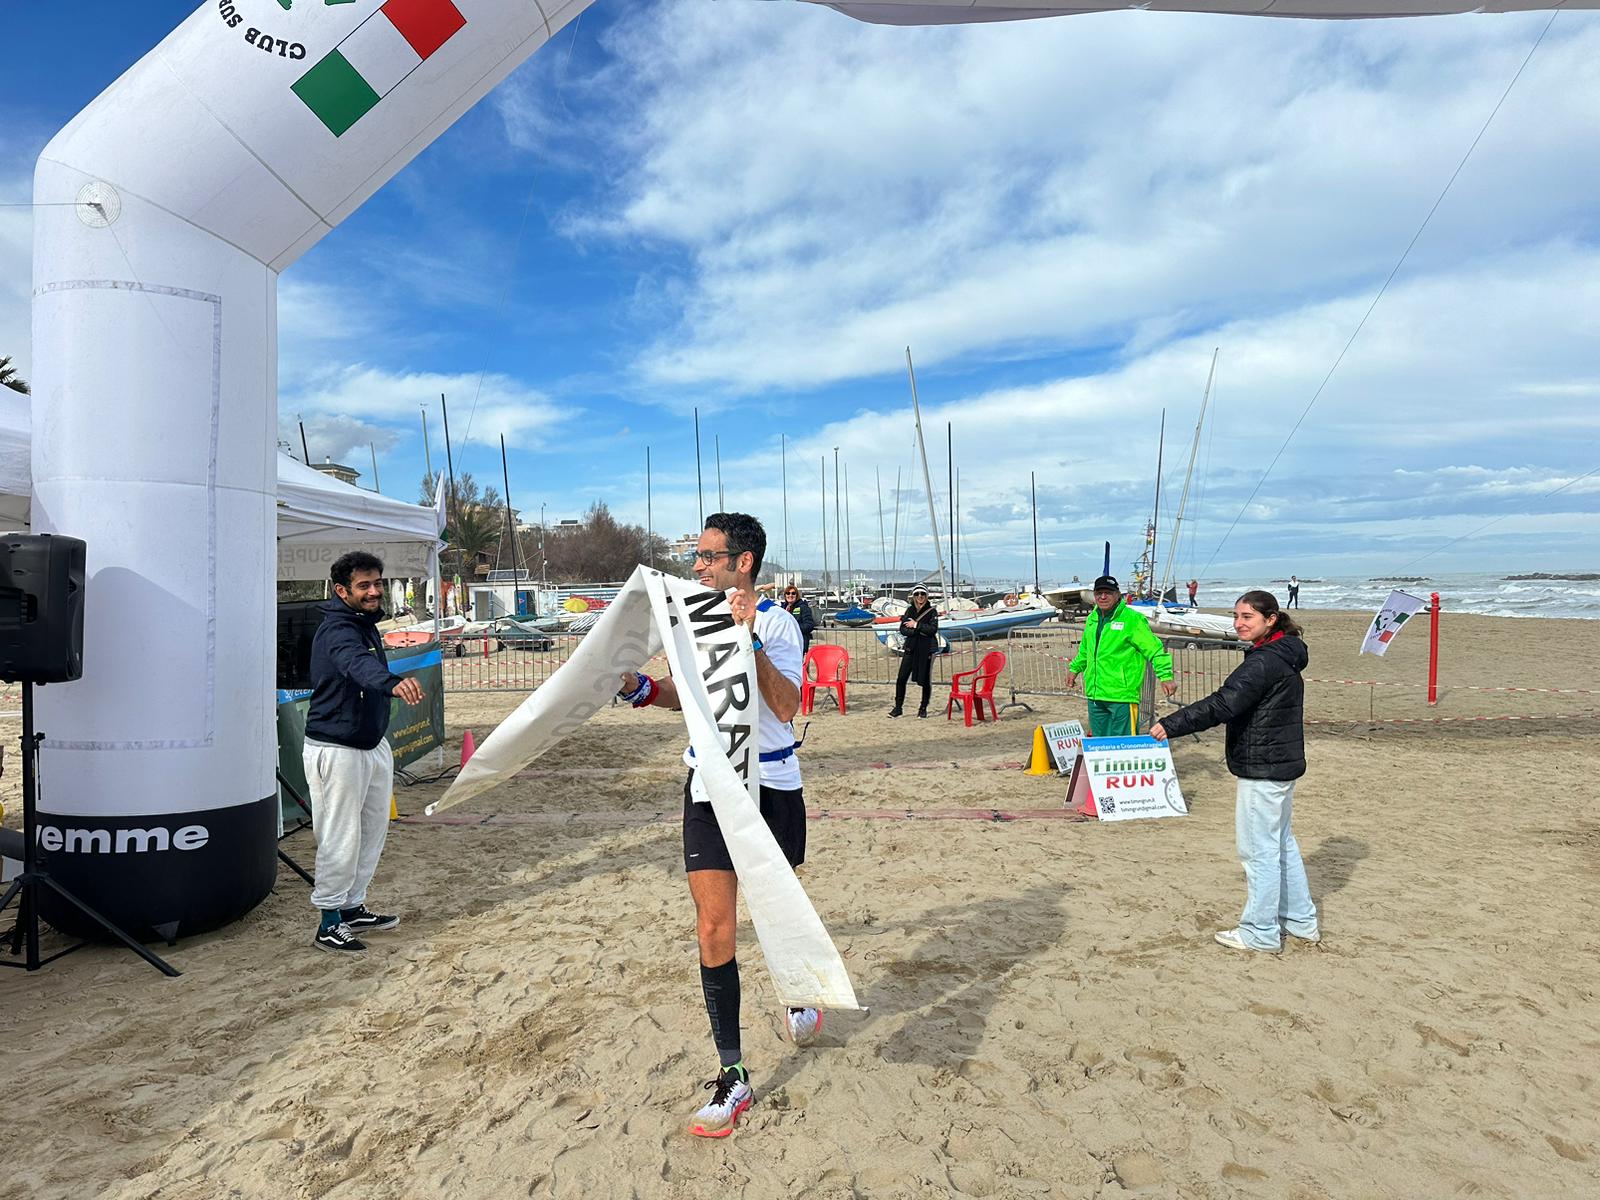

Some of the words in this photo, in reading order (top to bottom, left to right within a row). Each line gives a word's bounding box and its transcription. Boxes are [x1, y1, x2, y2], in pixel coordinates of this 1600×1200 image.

[244, 27, 306, 60] CLUB
[683, 589, 751, 792] MARAT
[1045, 723, 1082, 738] Timing
[1057, 737, 1079, 751] RUN
[1089, 756, 1167, 772] Timing
[1106, 774, 1155, 789] RUN
